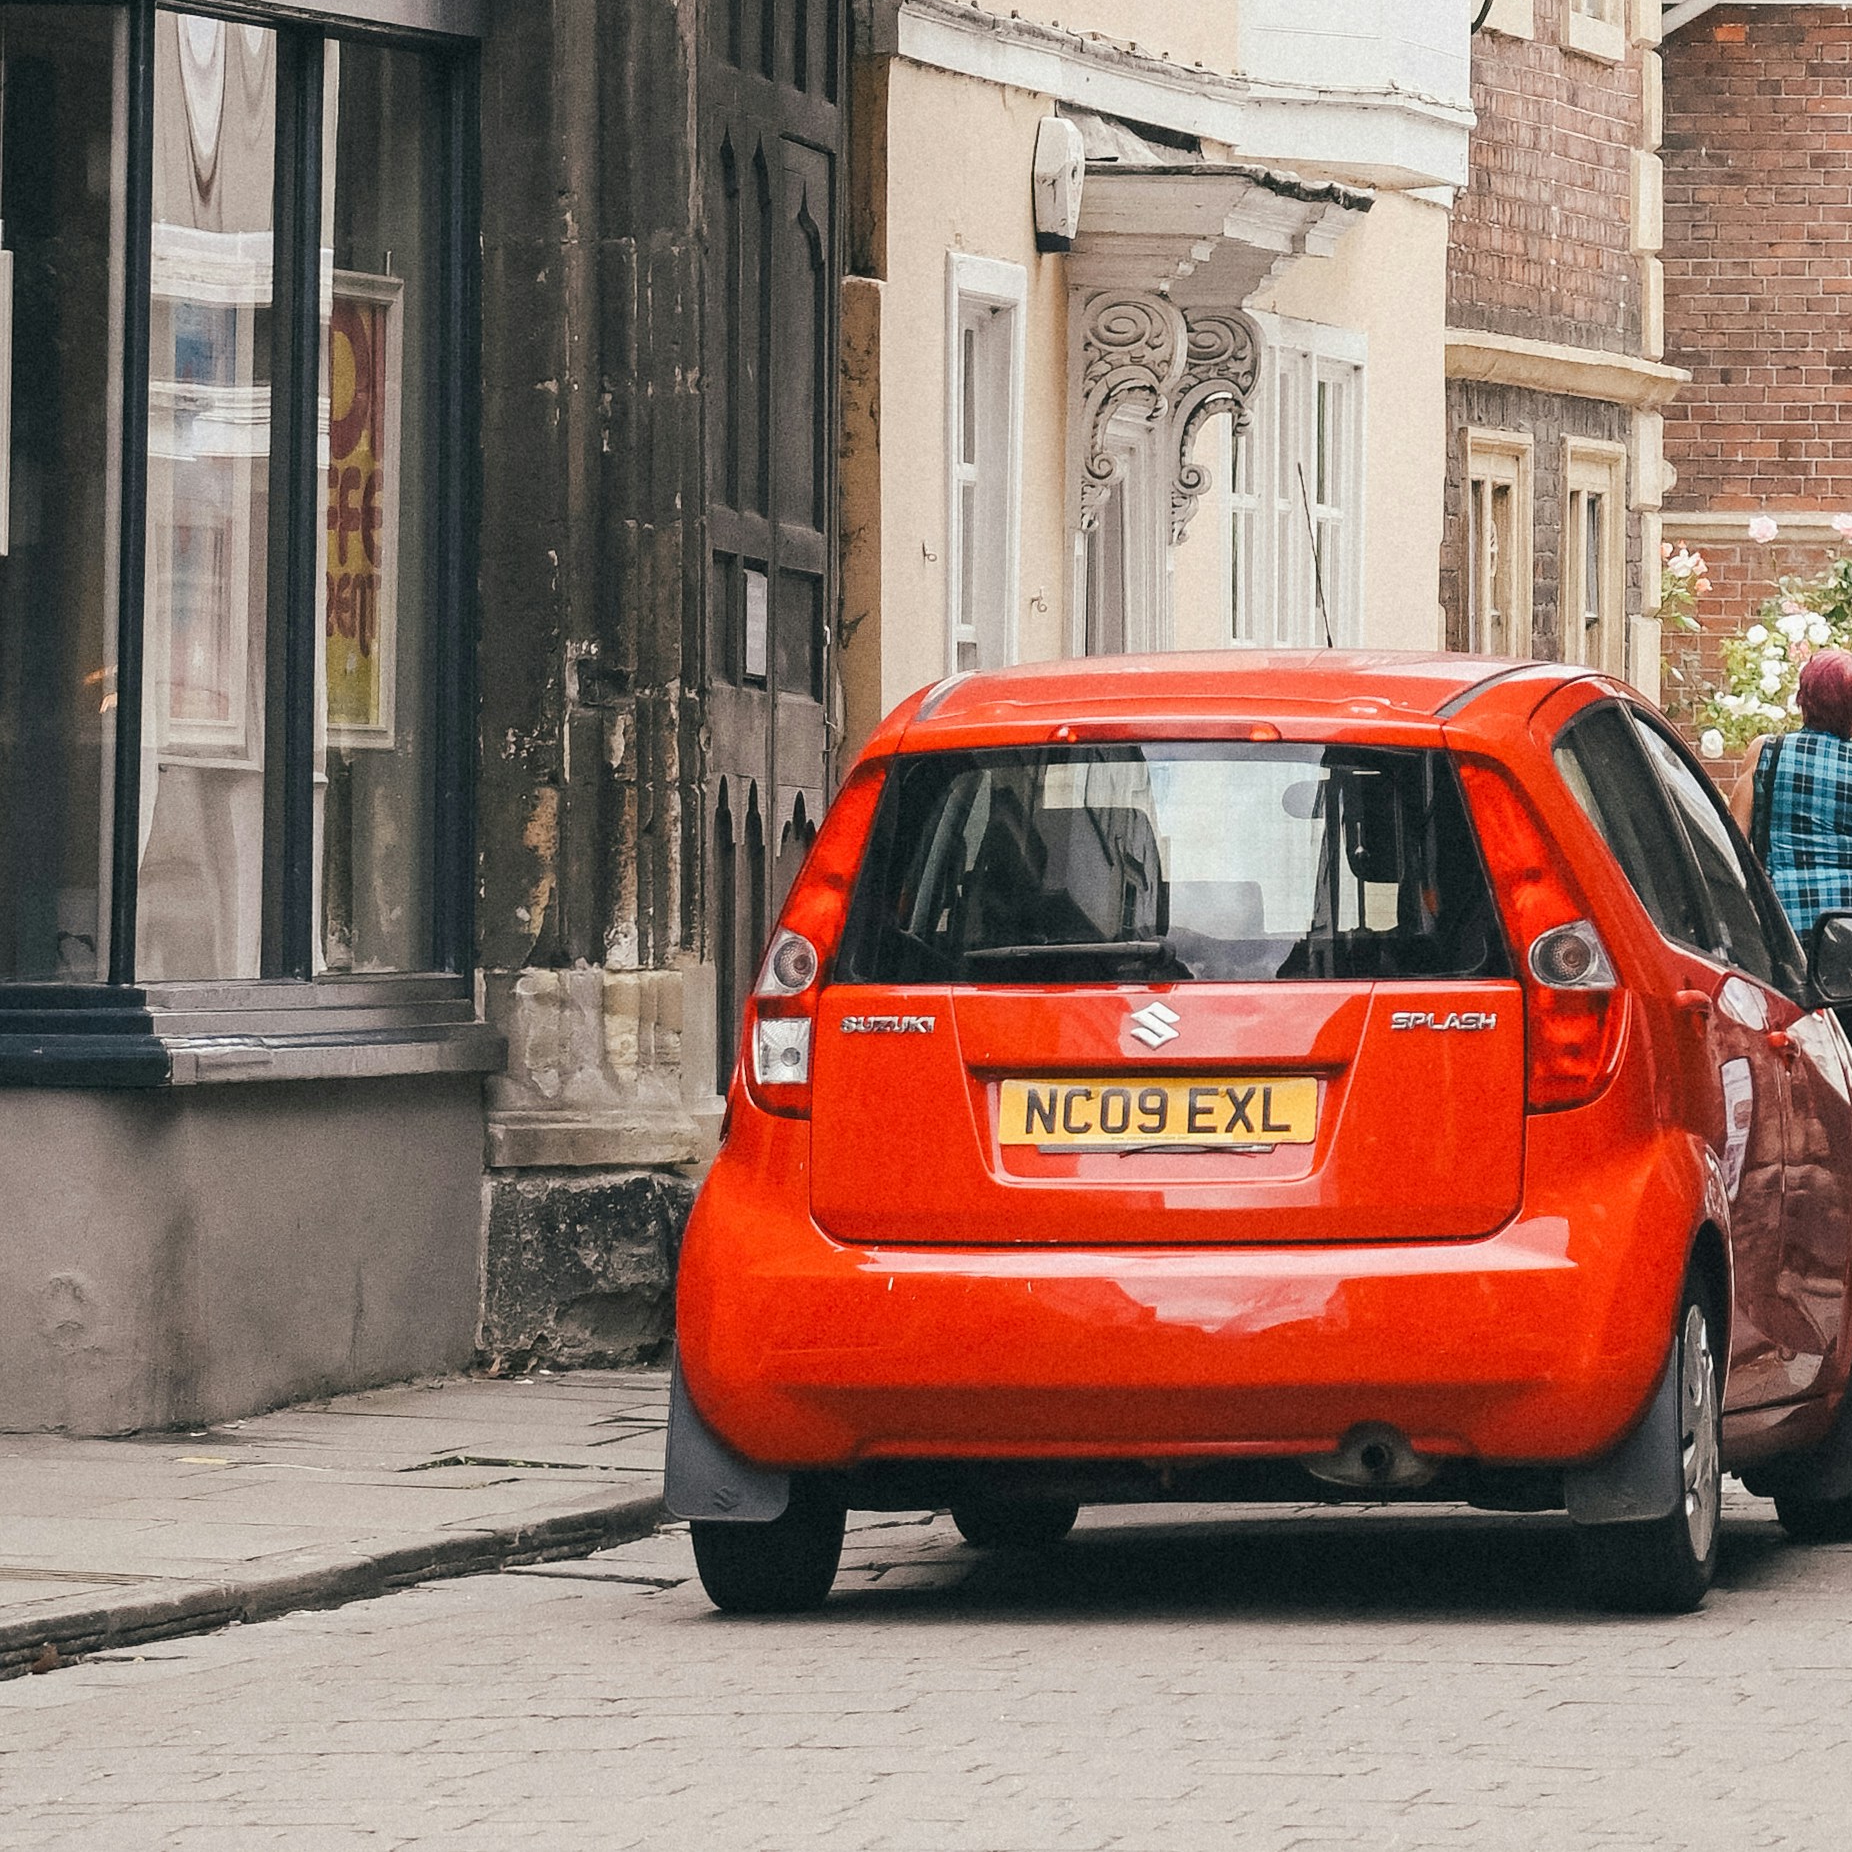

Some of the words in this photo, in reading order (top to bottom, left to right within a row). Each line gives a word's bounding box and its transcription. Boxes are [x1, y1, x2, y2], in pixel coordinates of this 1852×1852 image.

[840, 1015, 936, 1034] SUZUKI
[1390, 1011, 1497, 1031] SPLASH
[1025, 1087, 1168, 1134] NC09
[1187, 1086, 1291, 1134] EXL
